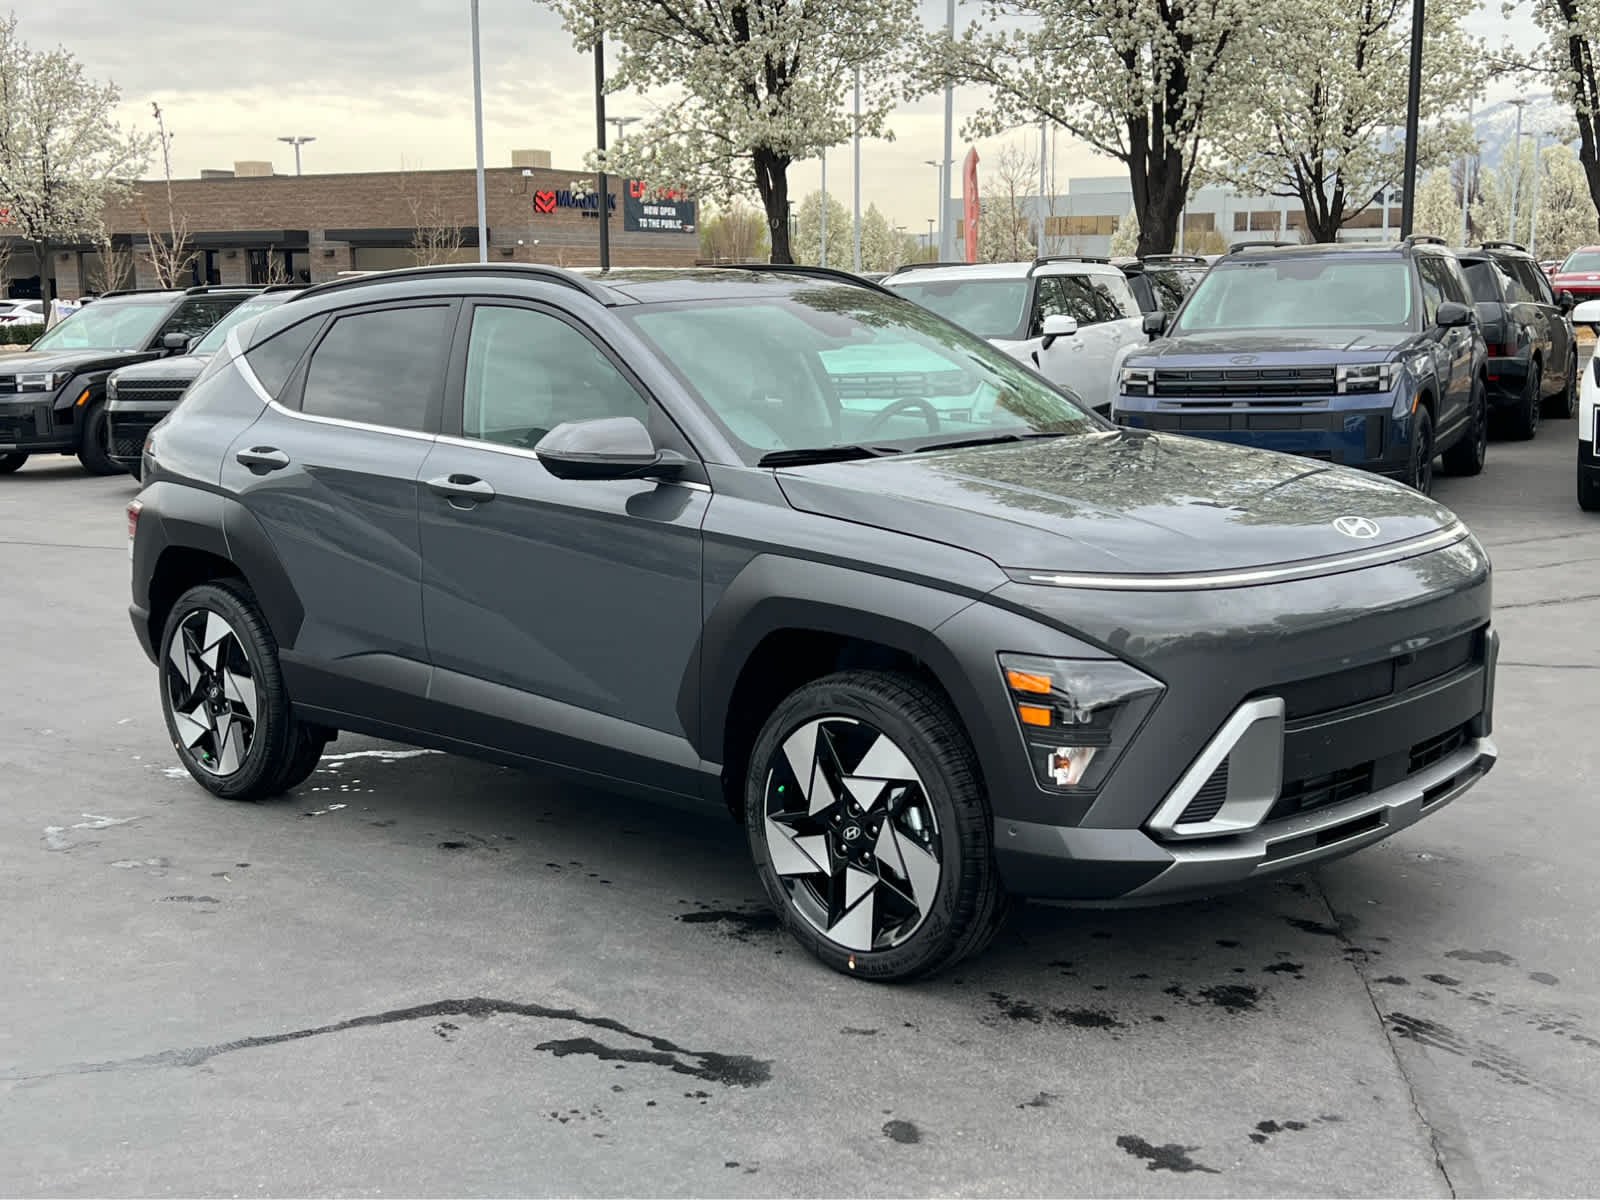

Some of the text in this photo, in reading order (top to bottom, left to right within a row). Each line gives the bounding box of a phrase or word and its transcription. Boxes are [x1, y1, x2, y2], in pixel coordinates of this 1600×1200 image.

[643, 206, 677, 217] NOW OPEN
[638, 218, 648, 228] TO
[648, 218, 660, 229] THE
[660, 219, 683, 230] PUBLIC
